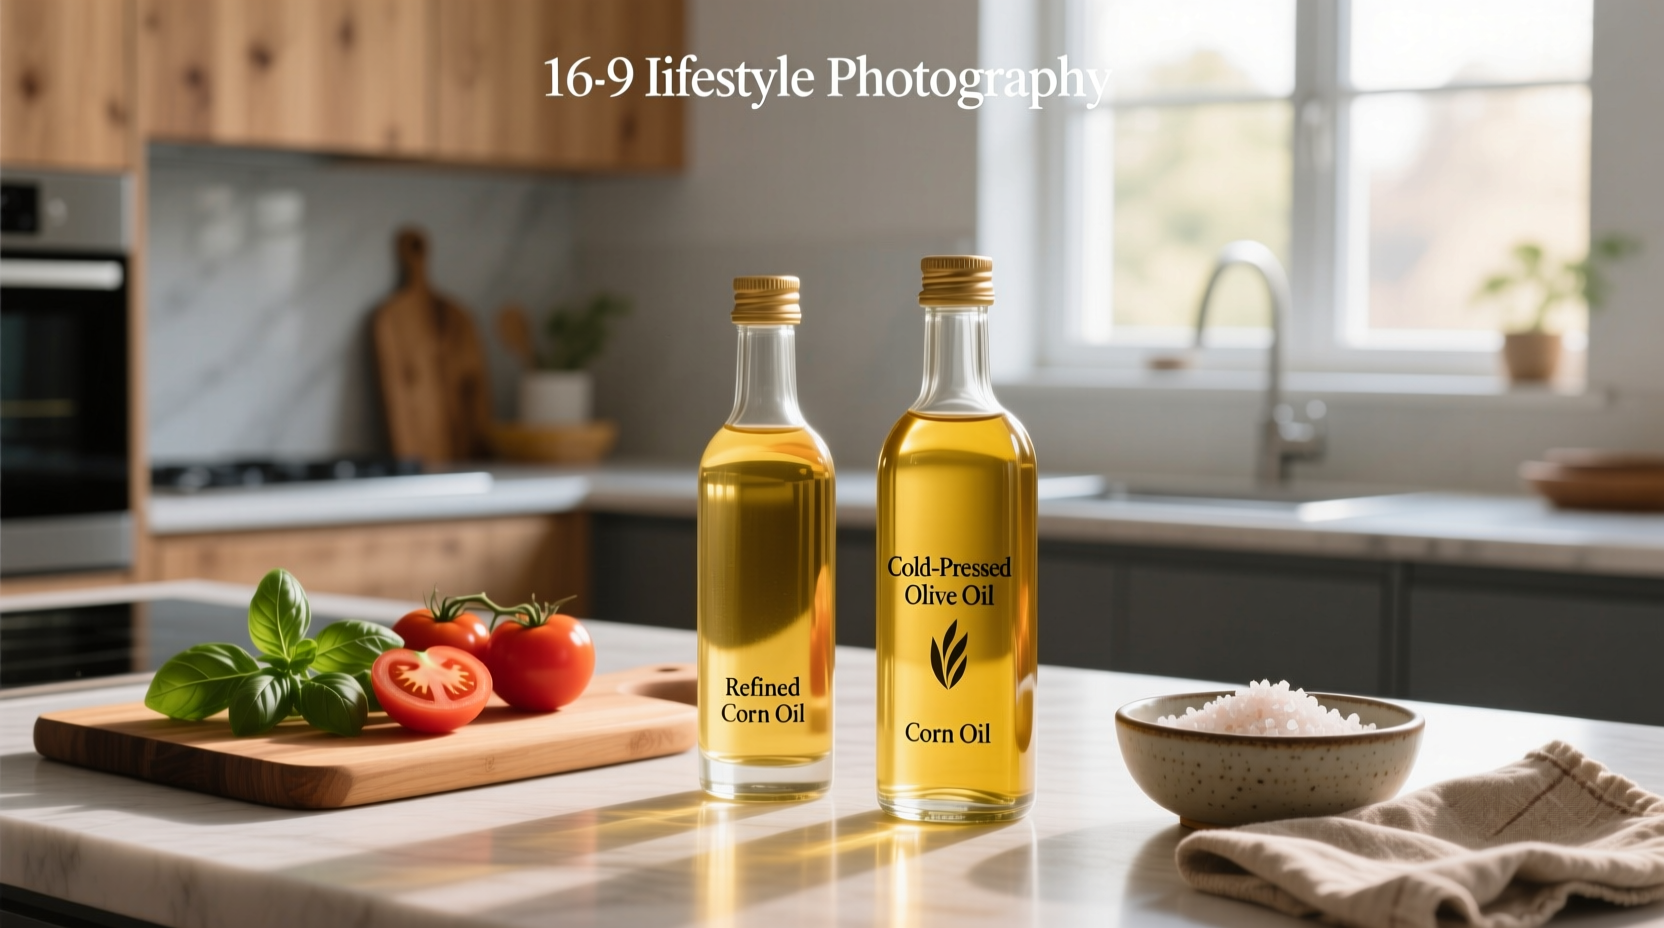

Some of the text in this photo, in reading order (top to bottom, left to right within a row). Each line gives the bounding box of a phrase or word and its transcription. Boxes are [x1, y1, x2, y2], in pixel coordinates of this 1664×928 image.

[887, 555, 1012, 579] Cold-Pressed
[904, 584, 995, 606] Olive Oil
[725, 676, 801, 698] Refined
[721, 703, 805, 723] Corn Oil
[905, 722, 991, 744] Corn Oil
